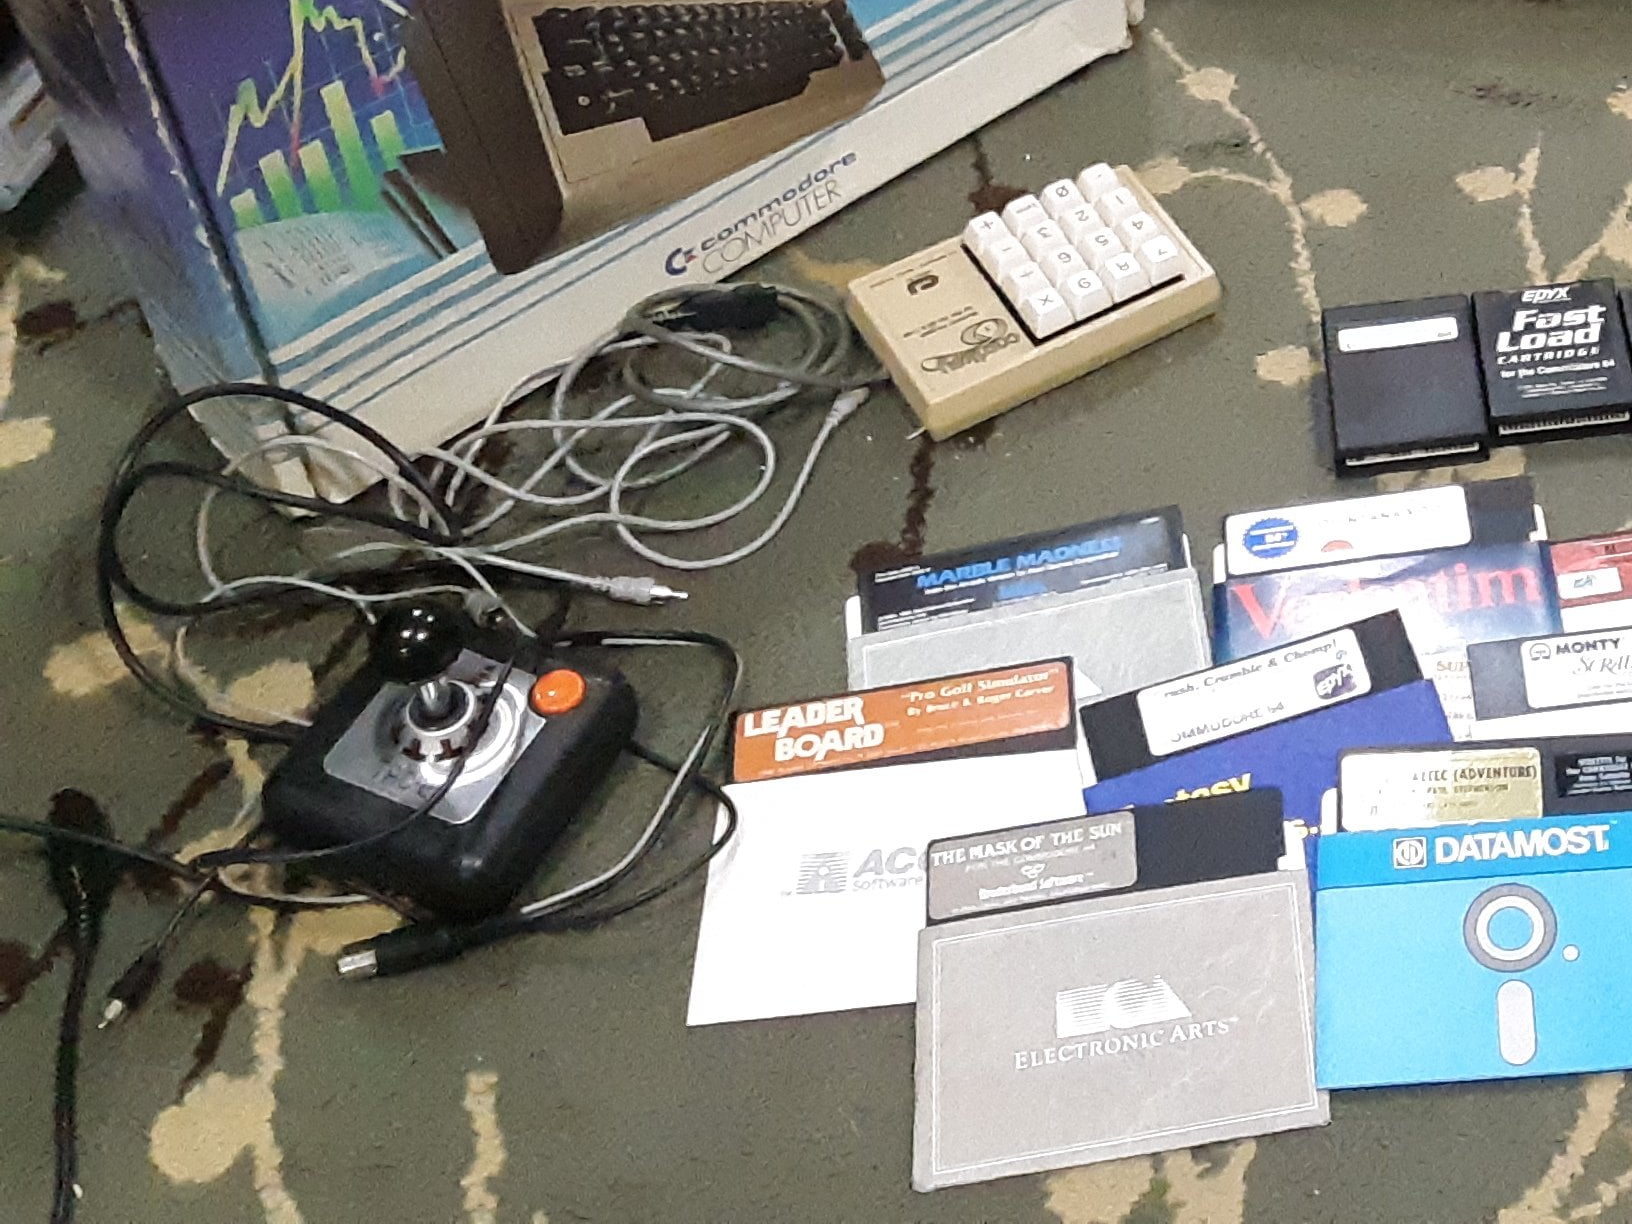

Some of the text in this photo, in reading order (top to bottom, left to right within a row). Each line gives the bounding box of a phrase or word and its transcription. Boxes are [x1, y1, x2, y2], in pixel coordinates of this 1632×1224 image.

[700, 151, 857, 253] commodore
[702, 179, 844, 275] COMPUTER
[1511, 302, 1608, 332] Fast
[1495, 325, 1603, 354] Load
[1495, 346, 1602, 367] CARTRIDGE
[1500, 358, 1616, 380] for the Commodore 64
[916, 557, 1014, 589] MARBLE
[1016, 536, 1124, 570] MADNESS
[1203, 664, 1262, 688] Crumble
[1283, 638, 1337, 664] Chomp!
[1554, 637, 1621, 656] MONTY
[939, 682, 975, 699] Golf
[976, 690, 1011, 707] Roger
[1014, 683, 1056, 700] Carver
[743, 696, 865, 739] LEADER
[773, 722, 885, 762] BOARD
[1453, 765, 1539, 782] (ADVENTURE)
[931, 821, 1123, 868] THE MASK OF THE SUN
[1434, 823, 1613, 866] DATAMOST
[1014, 1018, 1231, 1071] ELECTRONIC ARTS
